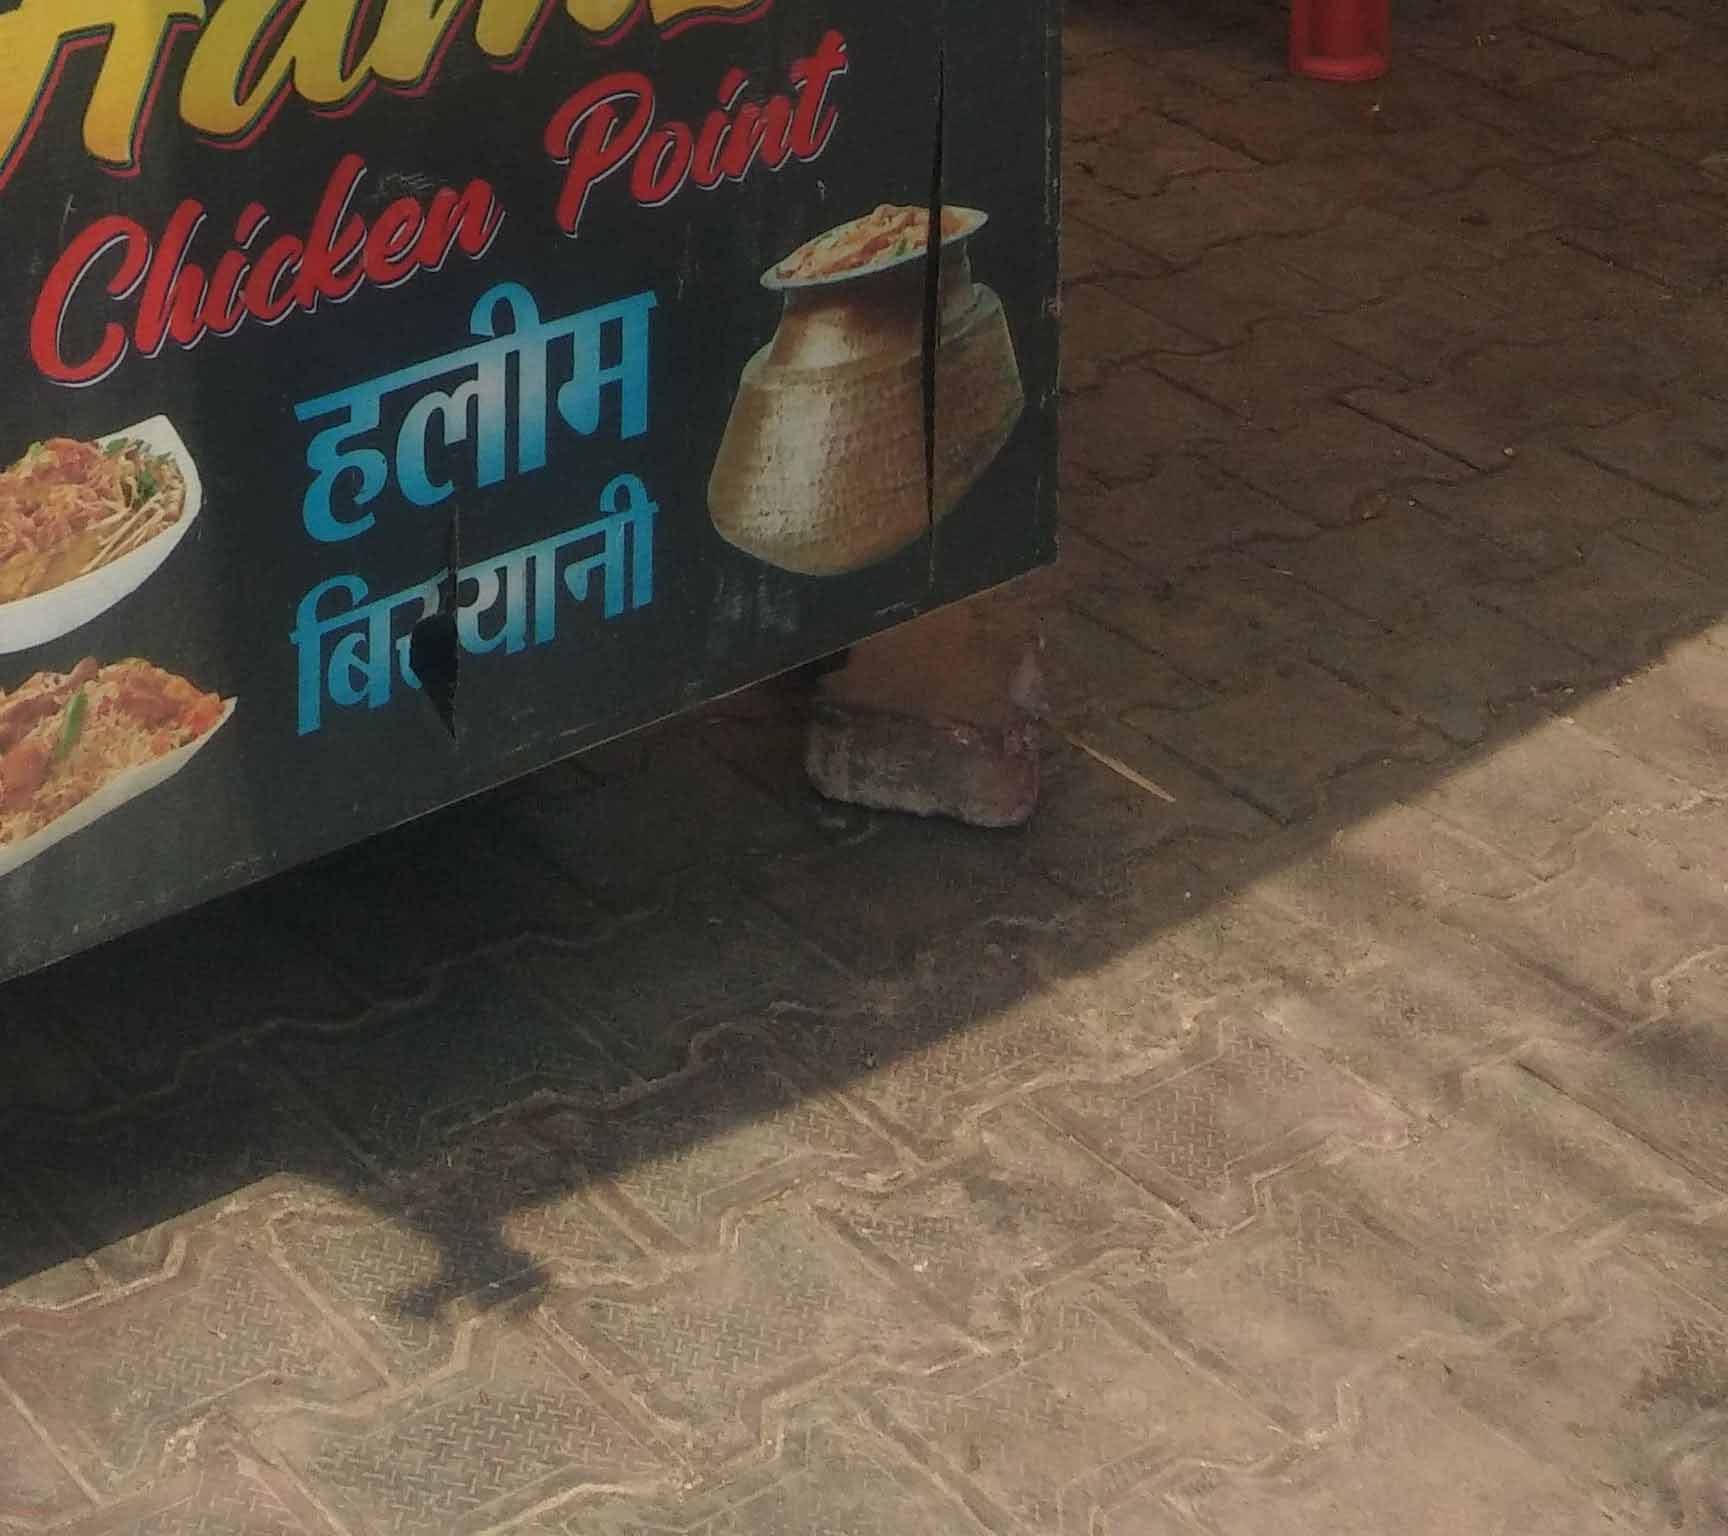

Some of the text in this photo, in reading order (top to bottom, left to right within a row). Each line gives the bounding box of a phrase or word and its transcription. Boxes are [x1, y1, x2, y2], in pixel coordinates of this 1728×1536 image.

[28, 29, 851, 387] Chicken Point
[294, 281, 660, 544] हलीम
